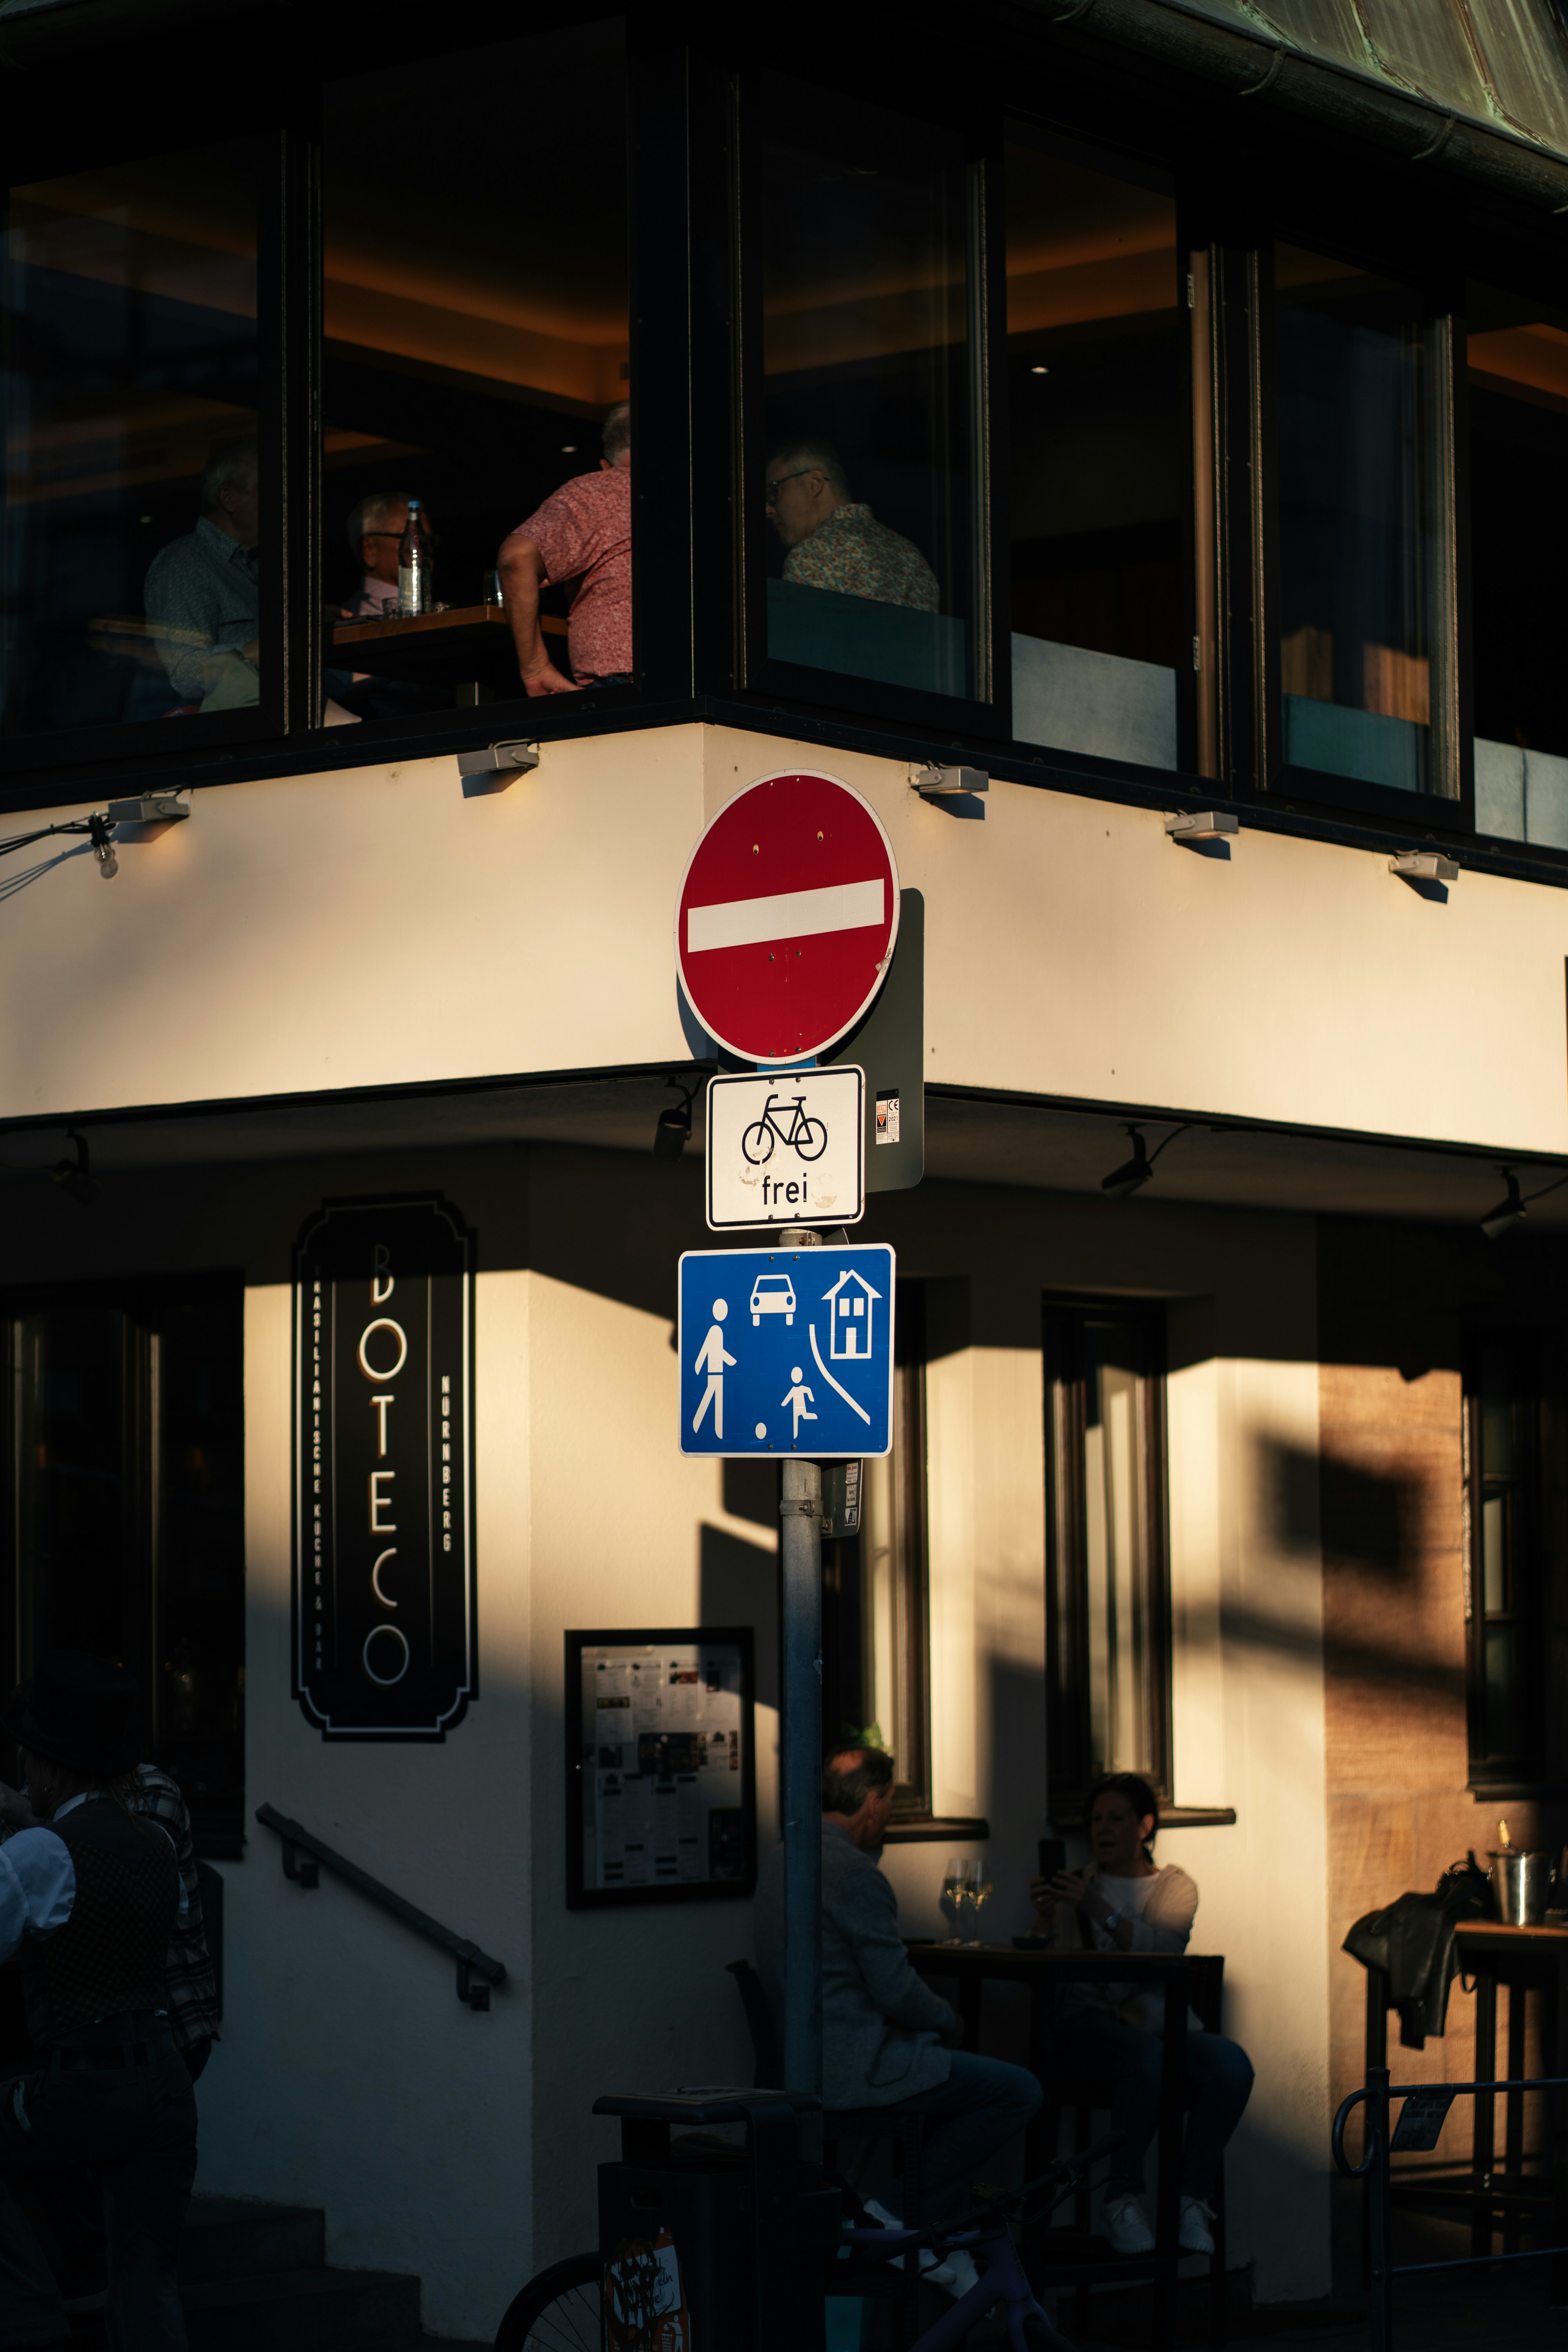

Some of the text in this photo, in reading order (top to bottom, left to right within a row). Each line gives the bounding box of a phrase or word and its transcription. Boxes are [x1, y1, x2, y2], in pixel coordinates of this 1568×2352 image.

[762, 1172, 807, 1205] frei
[888, 1100, 898, 1111] CE
[313, 1264, 323, 1670] BRASILIANISCHE KÜCHE & BAR
[359, 1243, 409, 1686] BOTECO
[442, 1375, 452, 1552] NÜRNBERG
